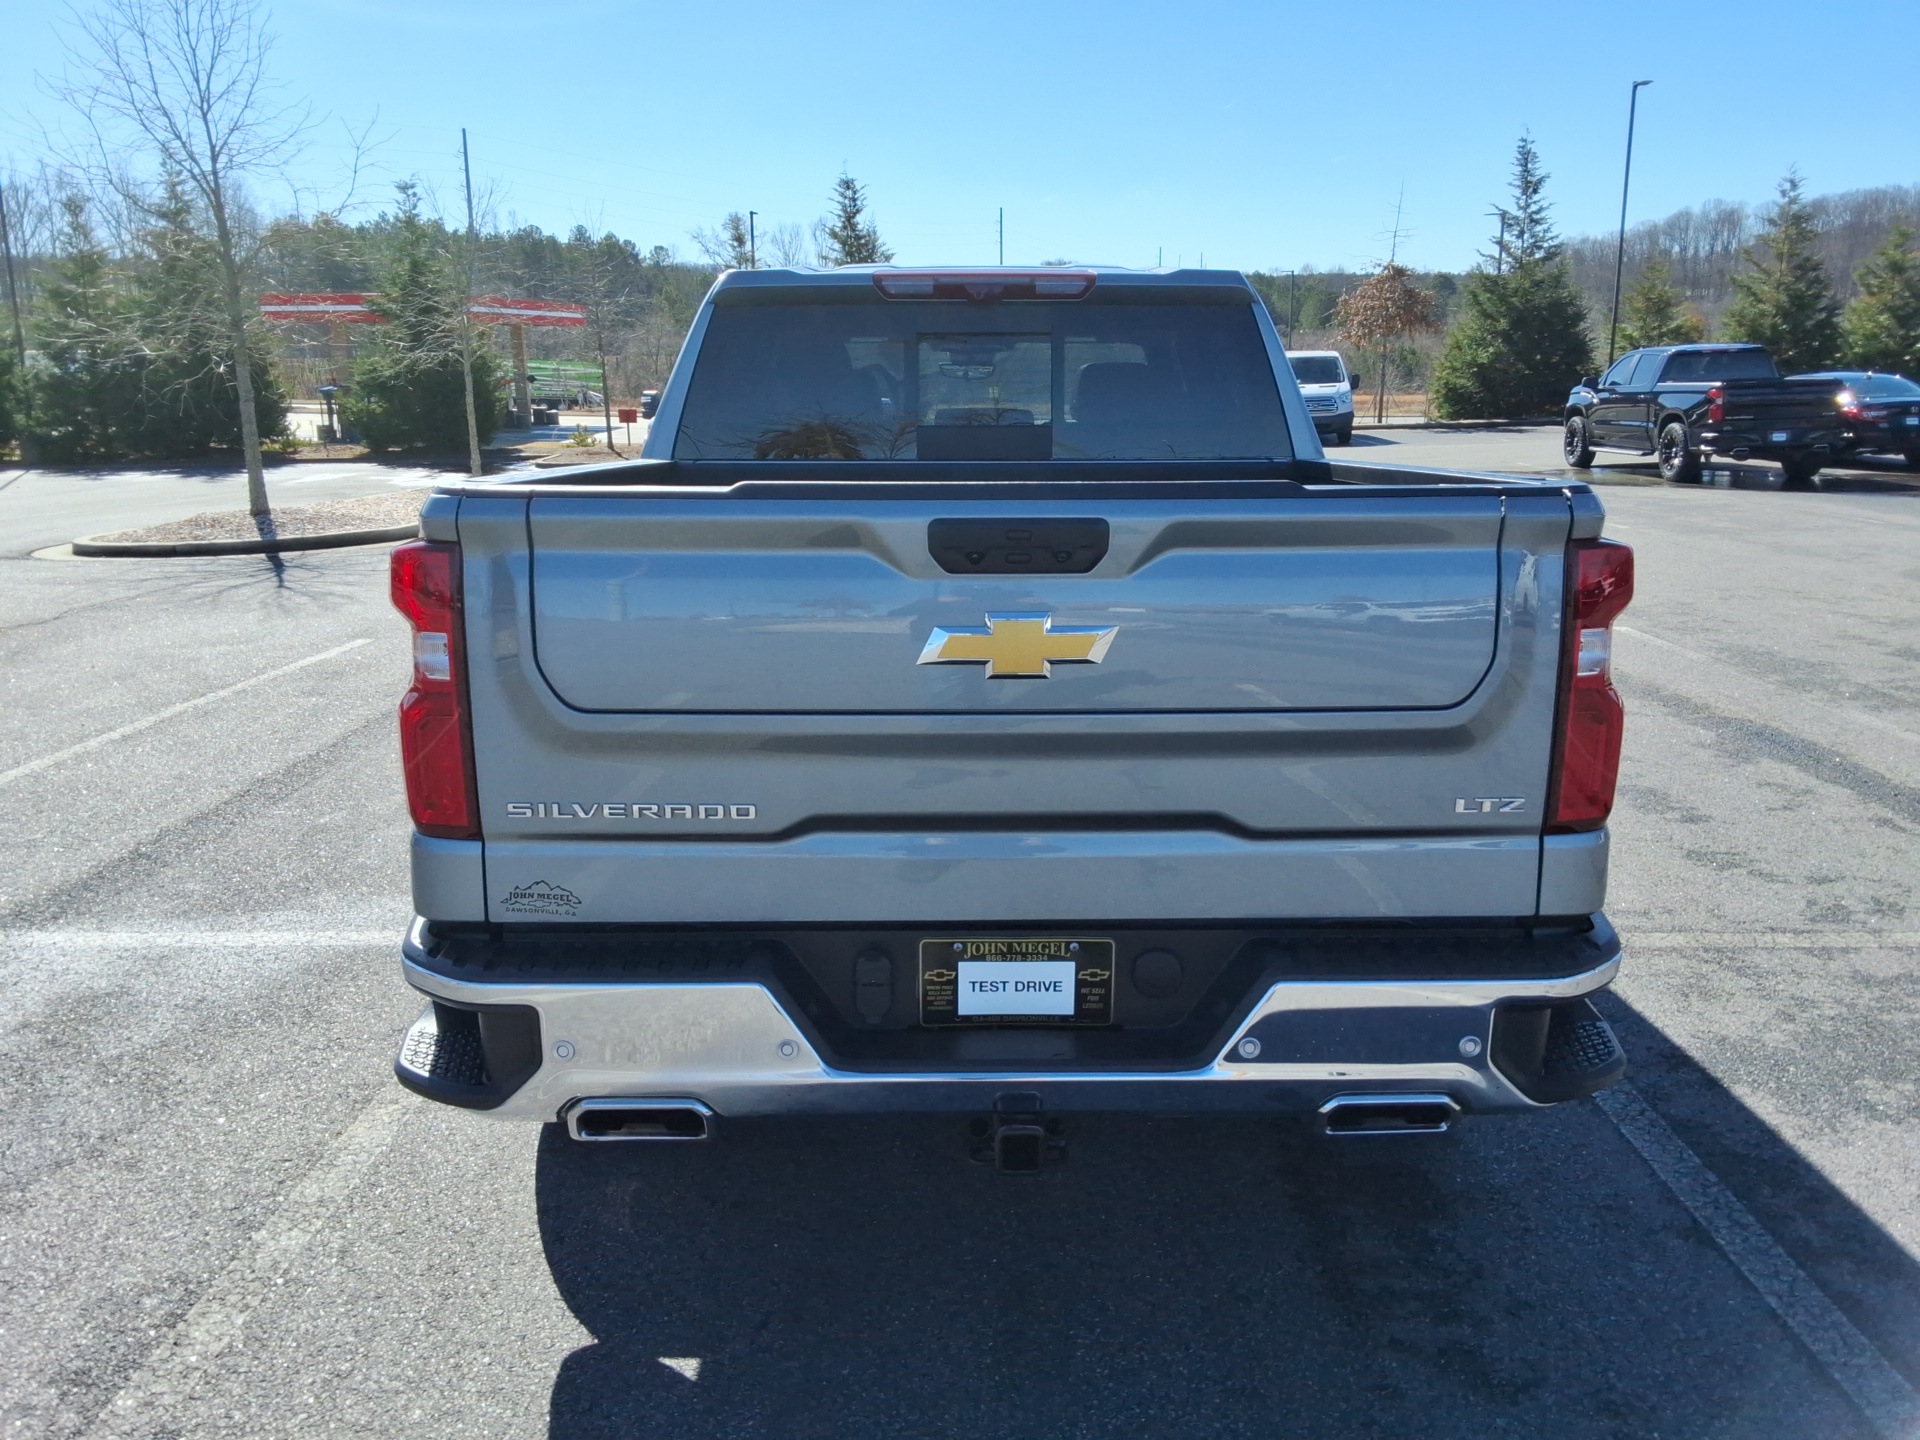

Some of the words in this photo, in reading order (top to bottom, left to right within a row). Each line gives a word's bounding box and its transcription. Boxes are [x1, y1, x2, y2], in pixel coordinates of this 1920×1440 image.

[506, 802, 757, 820] SILVERADO
[1455, 797, 1525, 813] LTZ
[509, 891, 535, 902] JOHN
[537, 893, 572, 903] MEGEL
[564, 909, 577, 917] GA
[964, 942, 1008, 960] JOHN
[1012, 942, 1071, 957] MEGEL
[968, 981, 1009, 993] TEST
[1014, 981, 1063, 993] DRIVE
